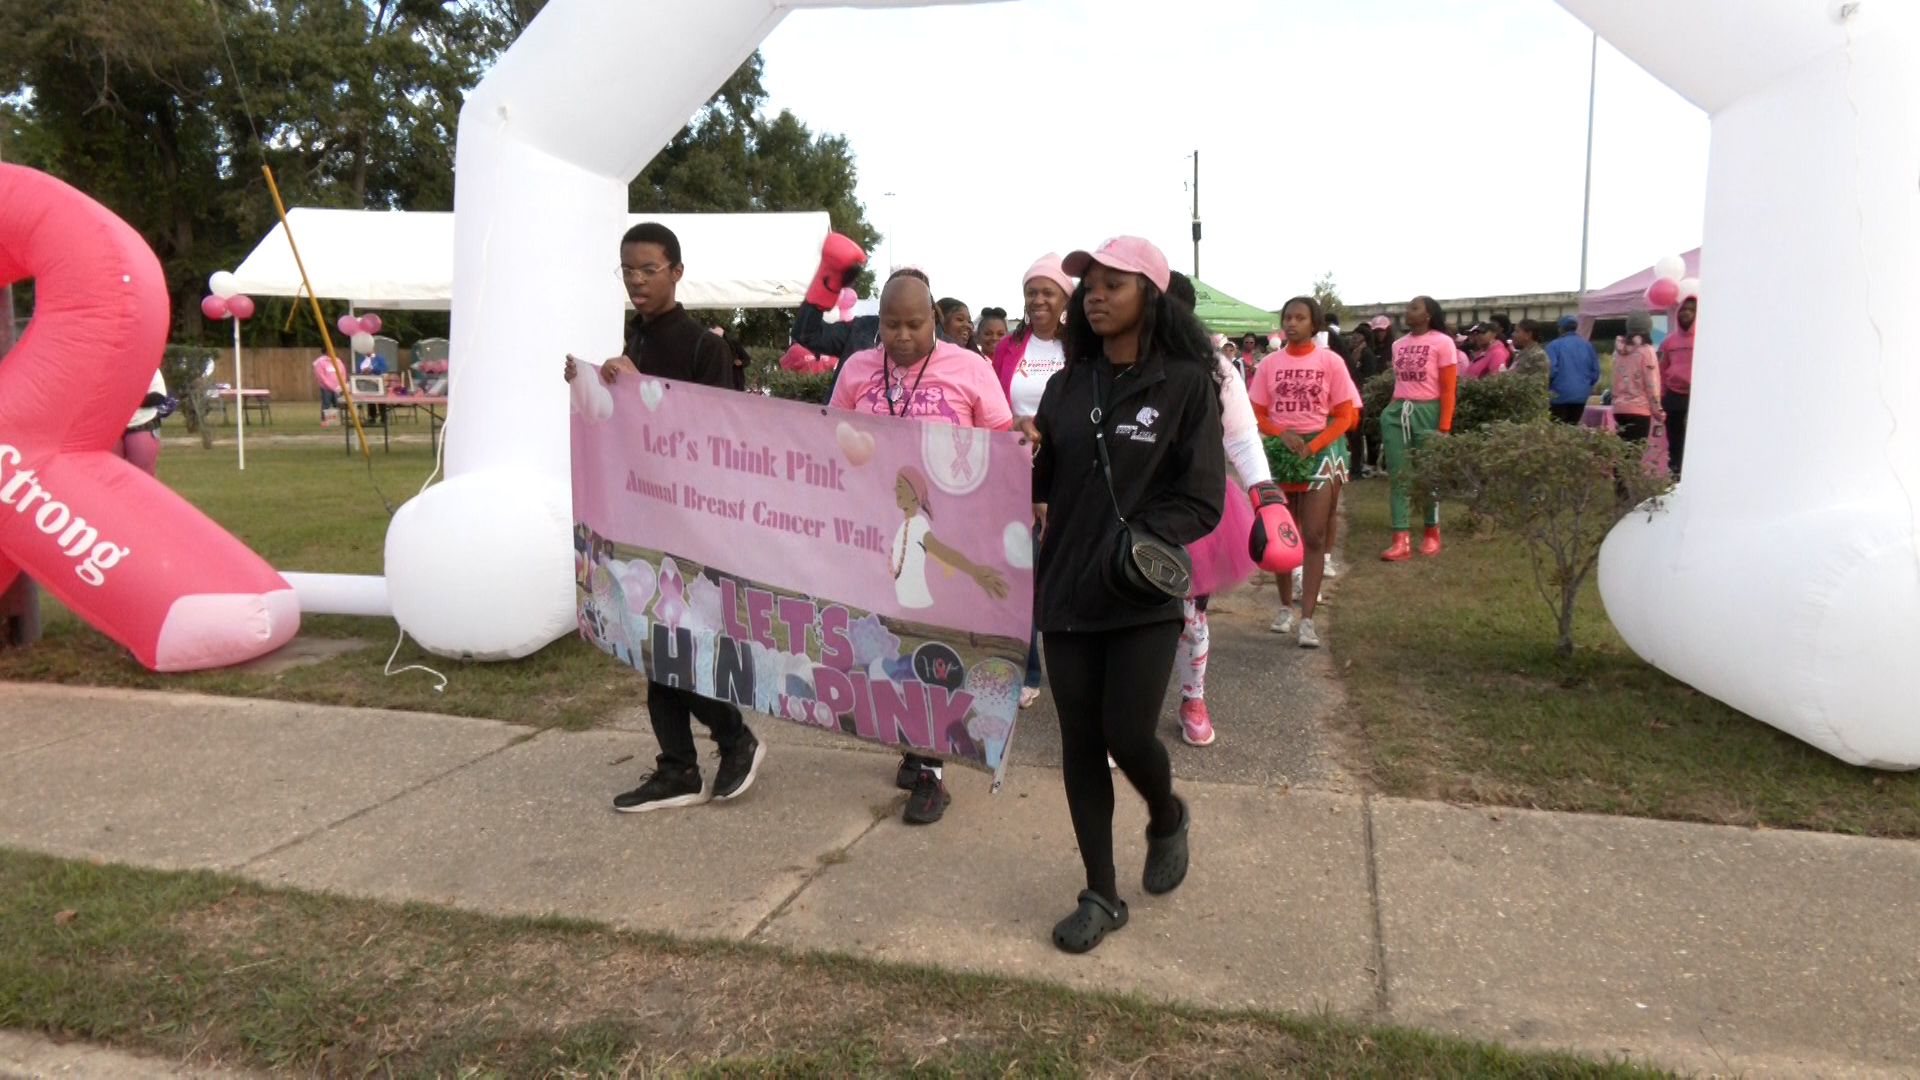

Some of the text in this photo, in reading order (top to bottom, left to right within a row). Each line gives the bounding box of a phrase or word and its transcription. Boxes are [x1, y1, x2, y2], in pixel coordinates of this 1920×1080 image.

[1275, 369, 1325, 383] CHEER
[642, 423, 846, 492] Let's Think Pink
[625, 469, 885, 554] Annual Breast Cancer Walk
[811, 663, 981, 758] PINK
